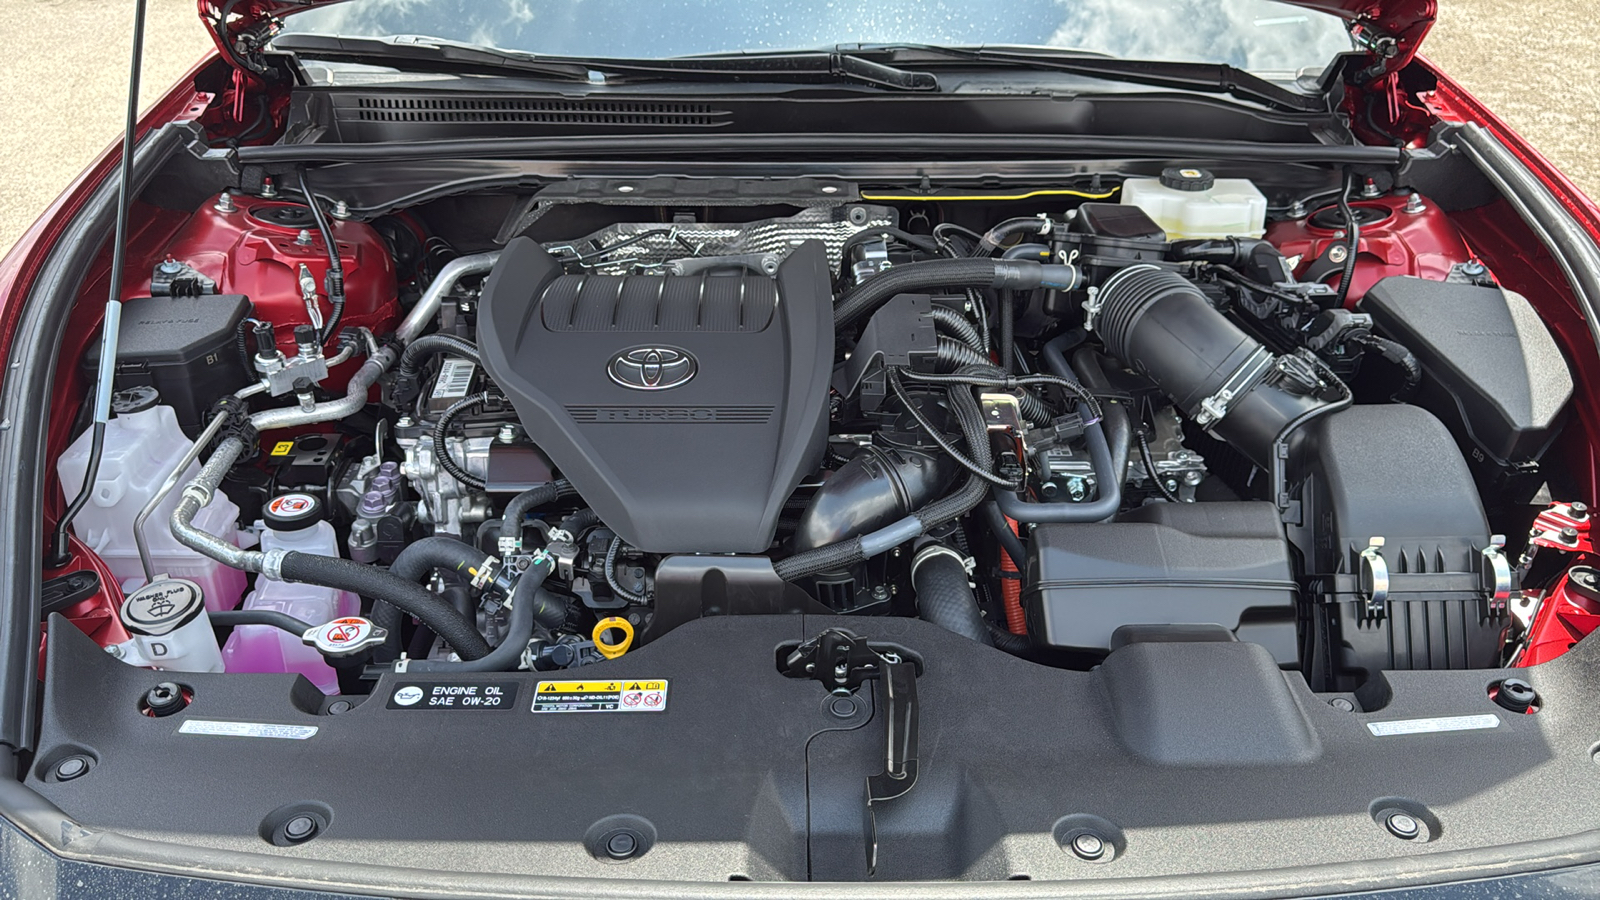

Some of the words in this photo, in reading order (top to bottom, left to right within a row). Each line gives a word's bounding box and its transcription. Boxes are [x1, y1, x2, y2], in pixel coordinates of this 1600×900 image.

[206, 352, 219, 366] B1
[600, 409, 713, 420] TURBO
[274, 444, 290, 454] L3
[1472, 447, 1485, 463] B9
[150, 642, 168, 657] D
[431, 686, 478, 696] ENGINE
[484, 686, 504, 696] OIL
[428, 696, 456, 706] SAE
[462, 696, 501, 706] 0W-20
